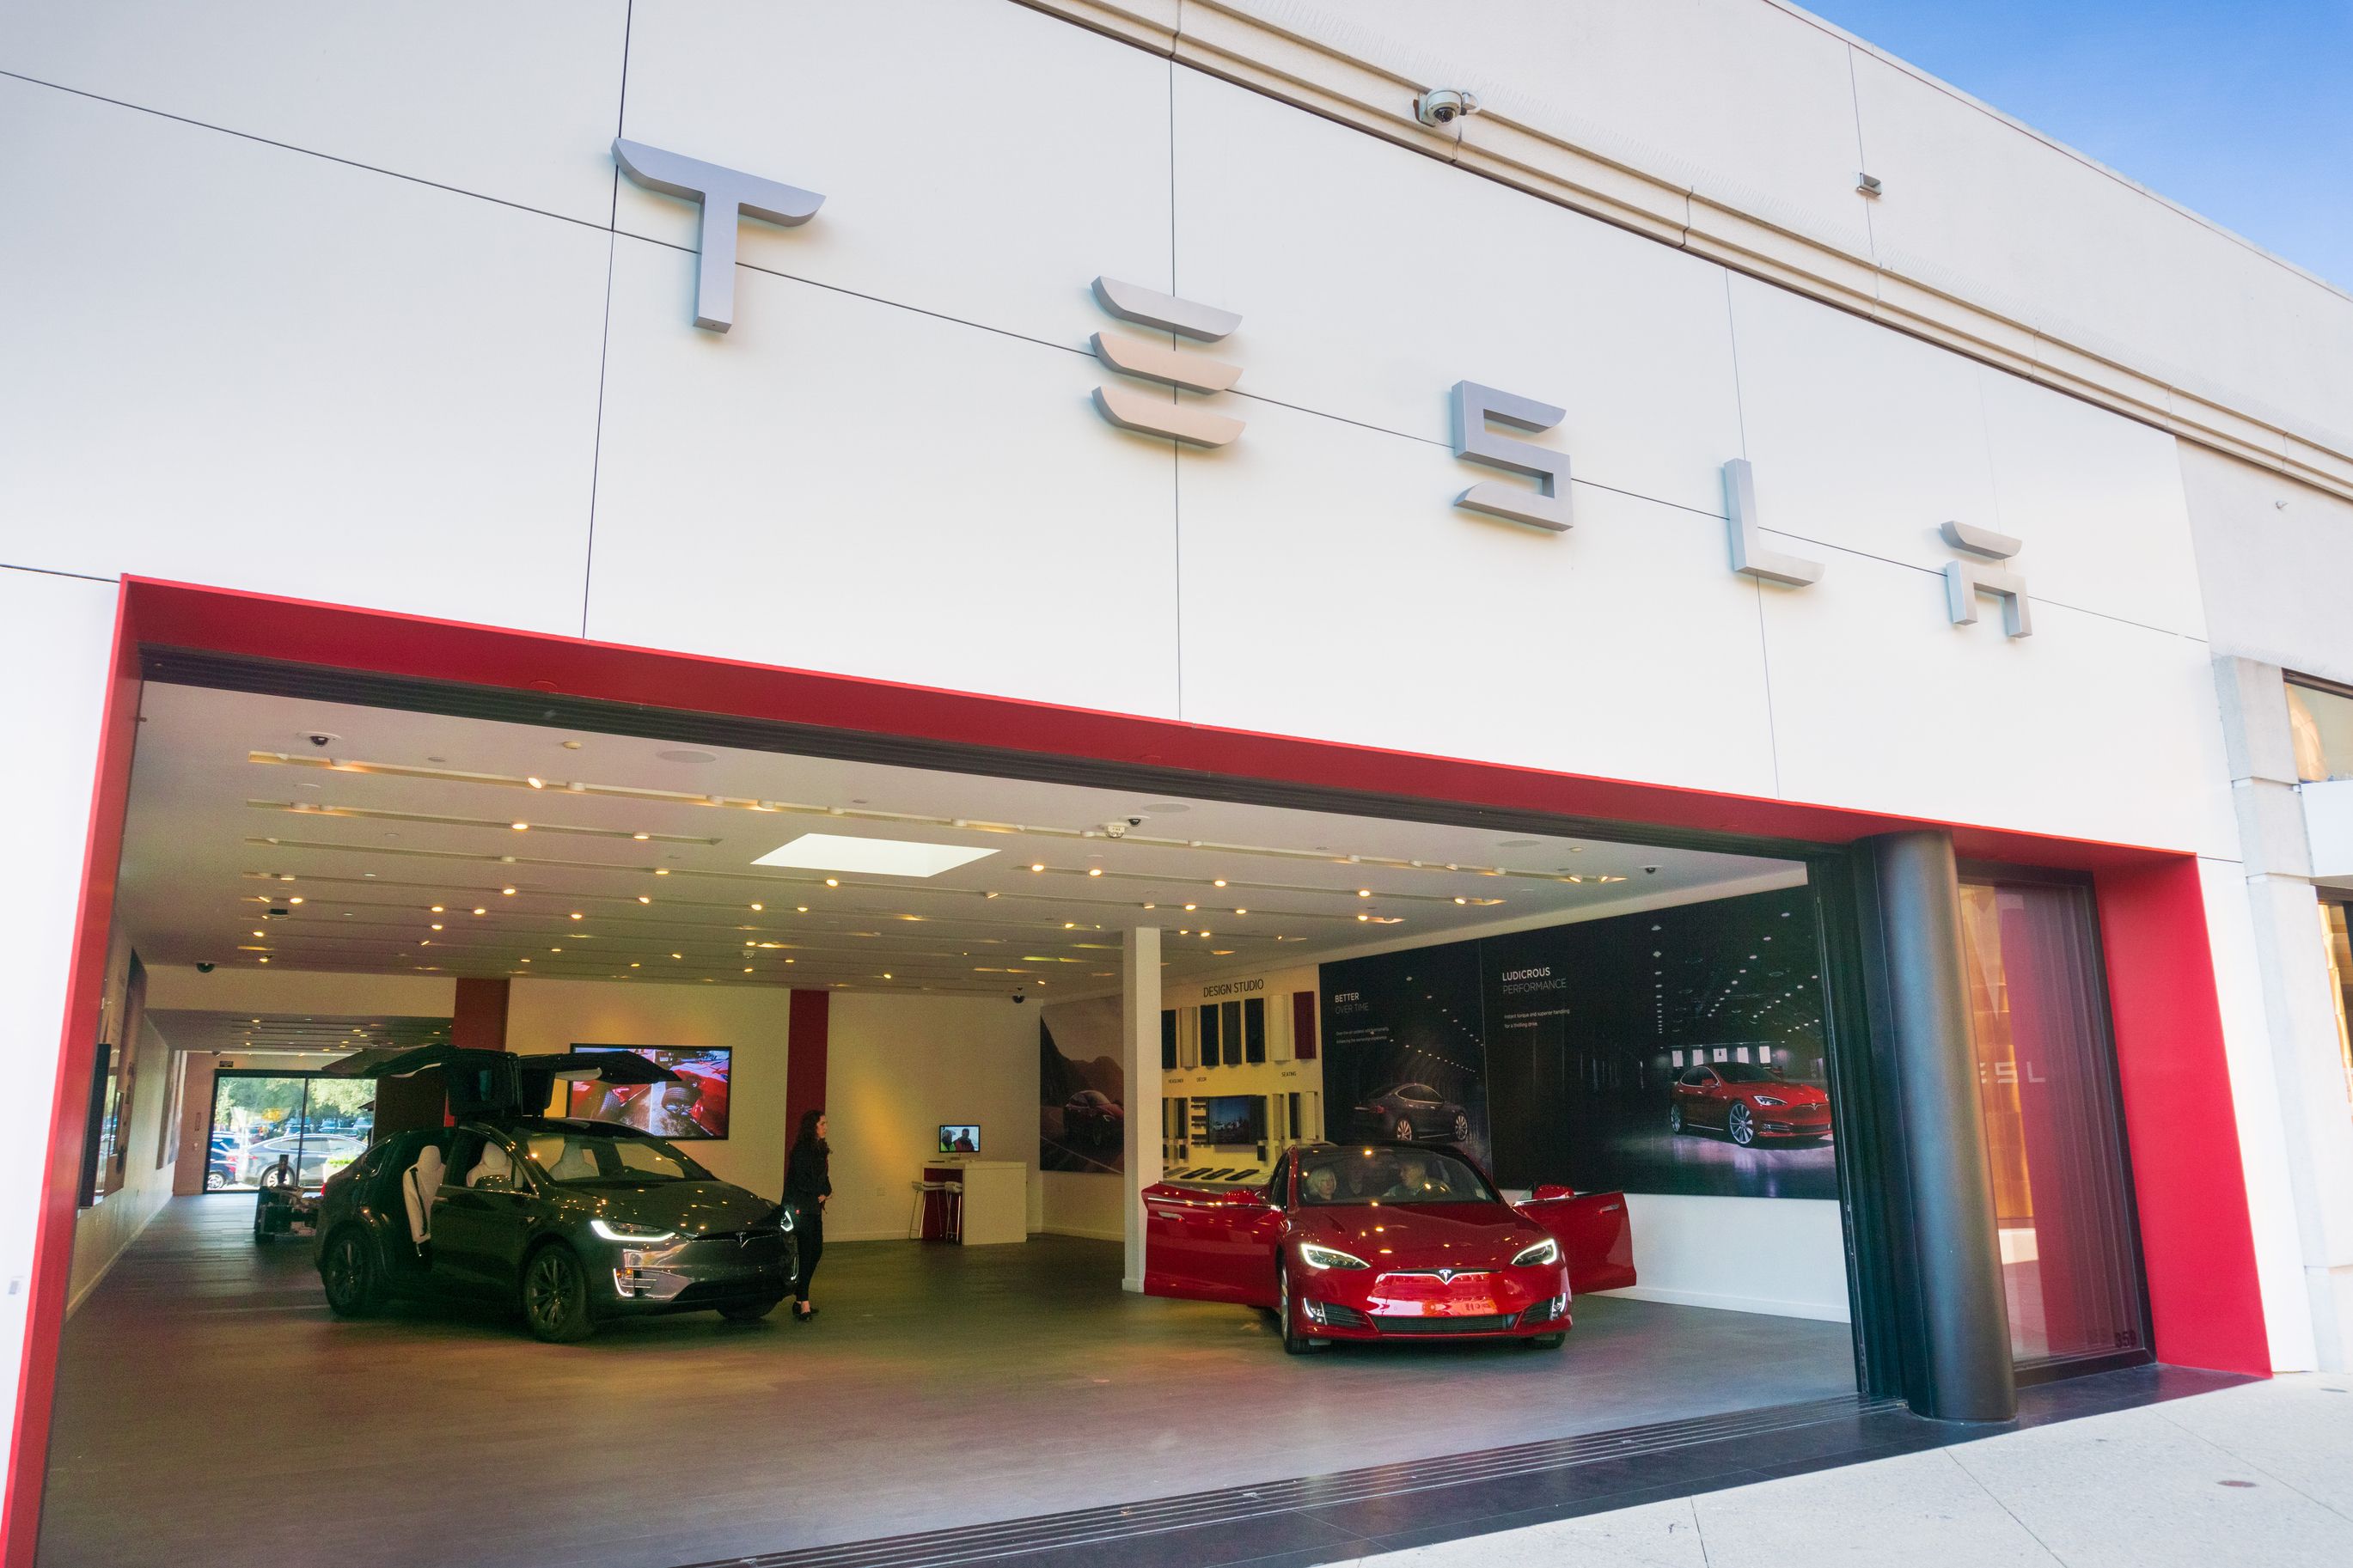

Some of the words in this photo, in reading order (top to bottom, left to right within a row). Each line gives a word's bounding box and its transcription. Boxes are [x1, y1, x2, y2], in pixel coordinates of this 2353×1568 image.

[611, 137, 2032, 638] TESLA
[1502, 967, 1550, 981] LUDICROUS
[1203, 984, 1232, 998] DESIGN
[1233, 979, 1264, 992] STUDIO
[1502, 978, 1567, 994] PERFORMANCE
[1335, 992, 1360, 1003] BETTER
[1335, 1004, 1354, 1014] OVER
[1354, 1002, 1369, 1011] TIME
